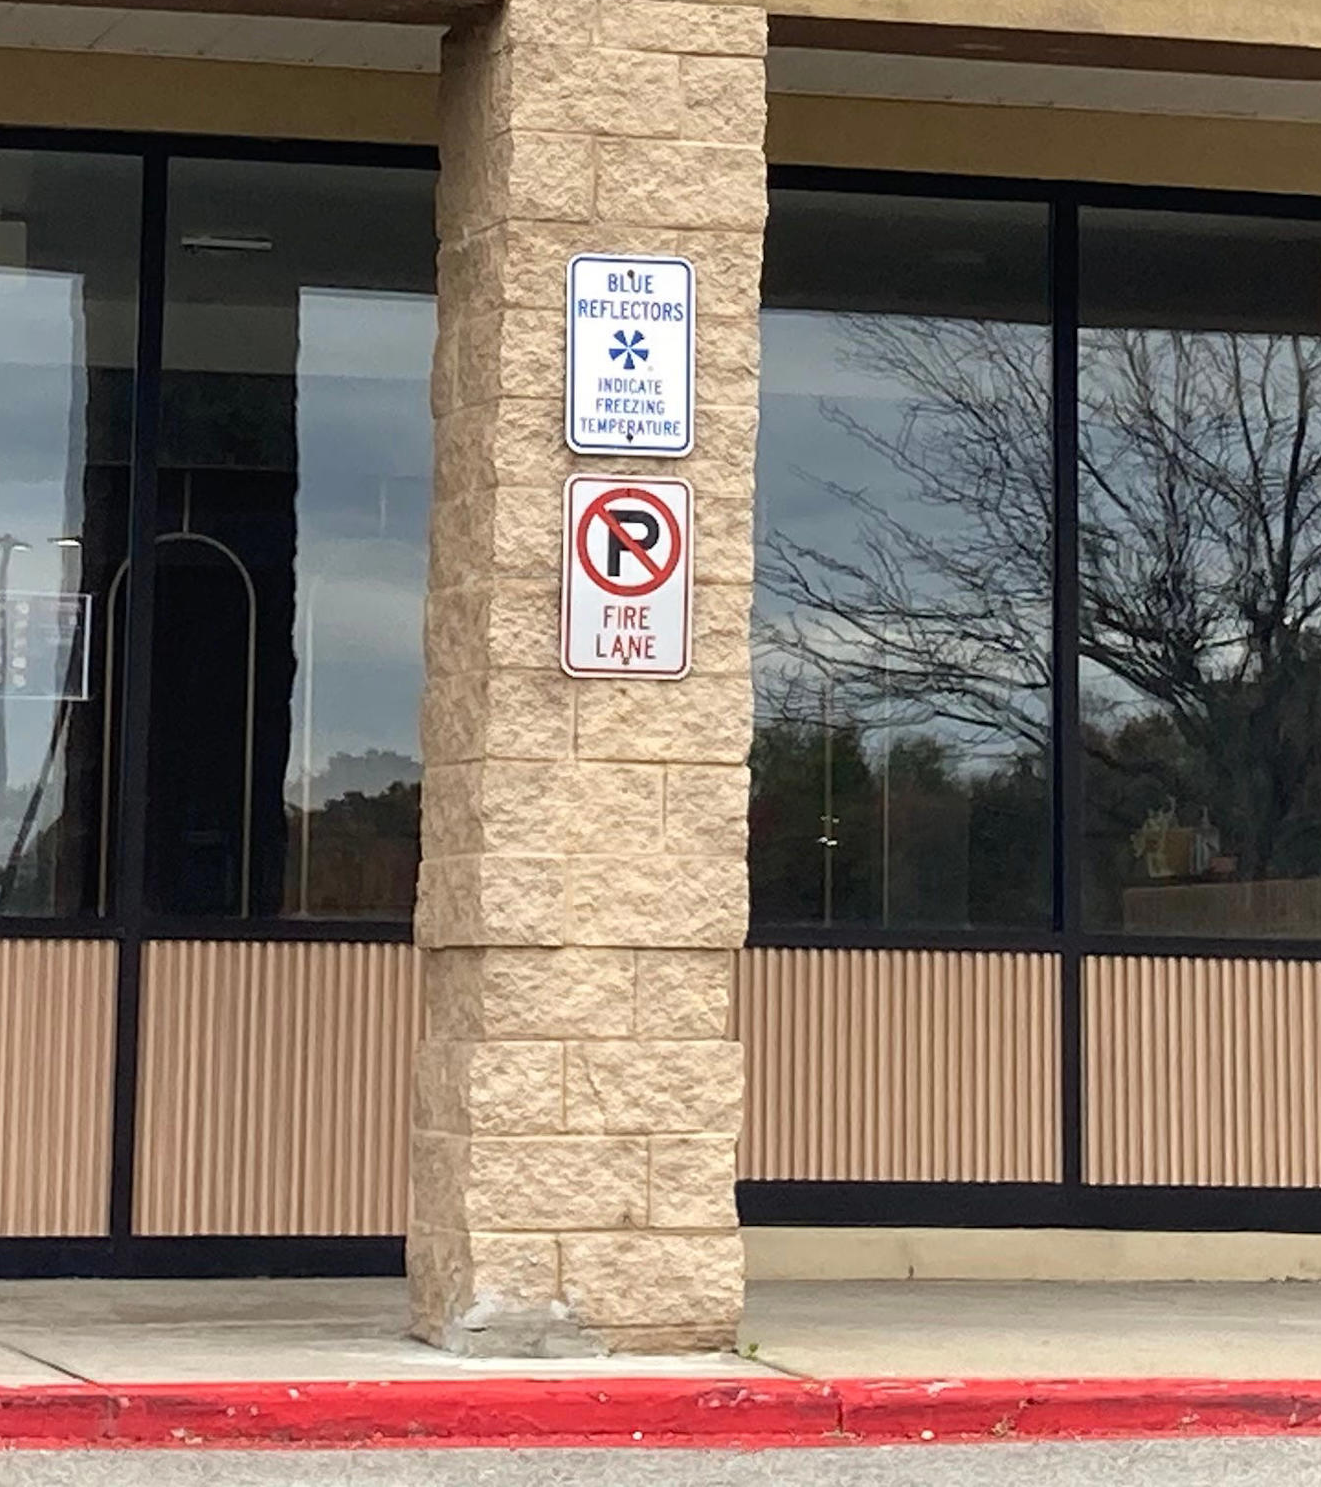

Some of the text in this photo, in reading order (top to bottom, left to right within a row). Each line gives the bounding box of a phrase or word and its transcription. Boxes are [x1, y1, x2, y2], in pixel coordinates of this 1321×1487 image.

[608, 273, 654, 294] BLUE
[578, 299, 684, 321] REFLECTORS
[598, 378, 662, 395] INDICATE
[596, 398, 665, 415] FREEZING
[580, 417, 681, 436] TEMPERATURE
[603, 605, 650, 630] FIRE
[596, 634, 656, 659] LANE
